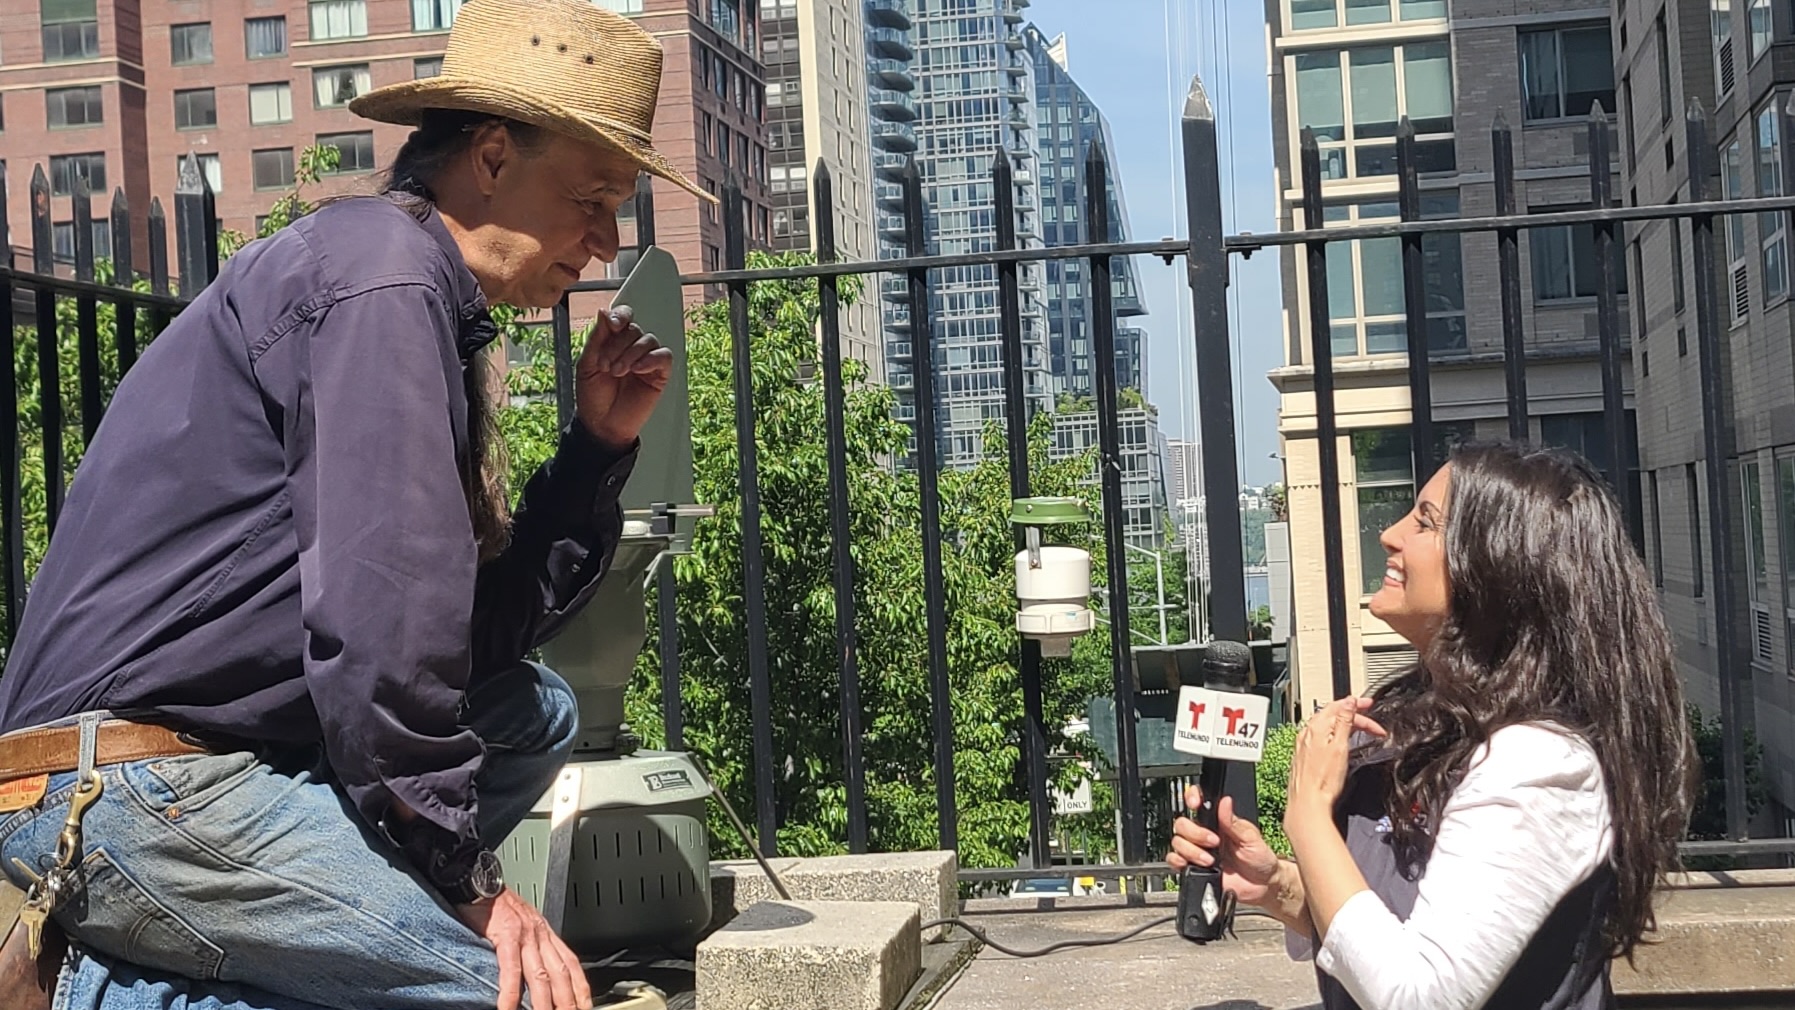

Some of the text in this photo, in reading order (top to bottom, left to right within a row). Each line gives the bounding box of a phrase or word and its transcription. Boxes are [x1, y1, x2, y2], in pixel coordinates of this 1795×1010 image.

[1238, 722, 1259, 738] 47
[1178, 730, 1210, 743] TELEMUNDO
[1216, 737, 1259, 749] TELEMUNDO
[1067, 801, 1087, 809] ONLY
